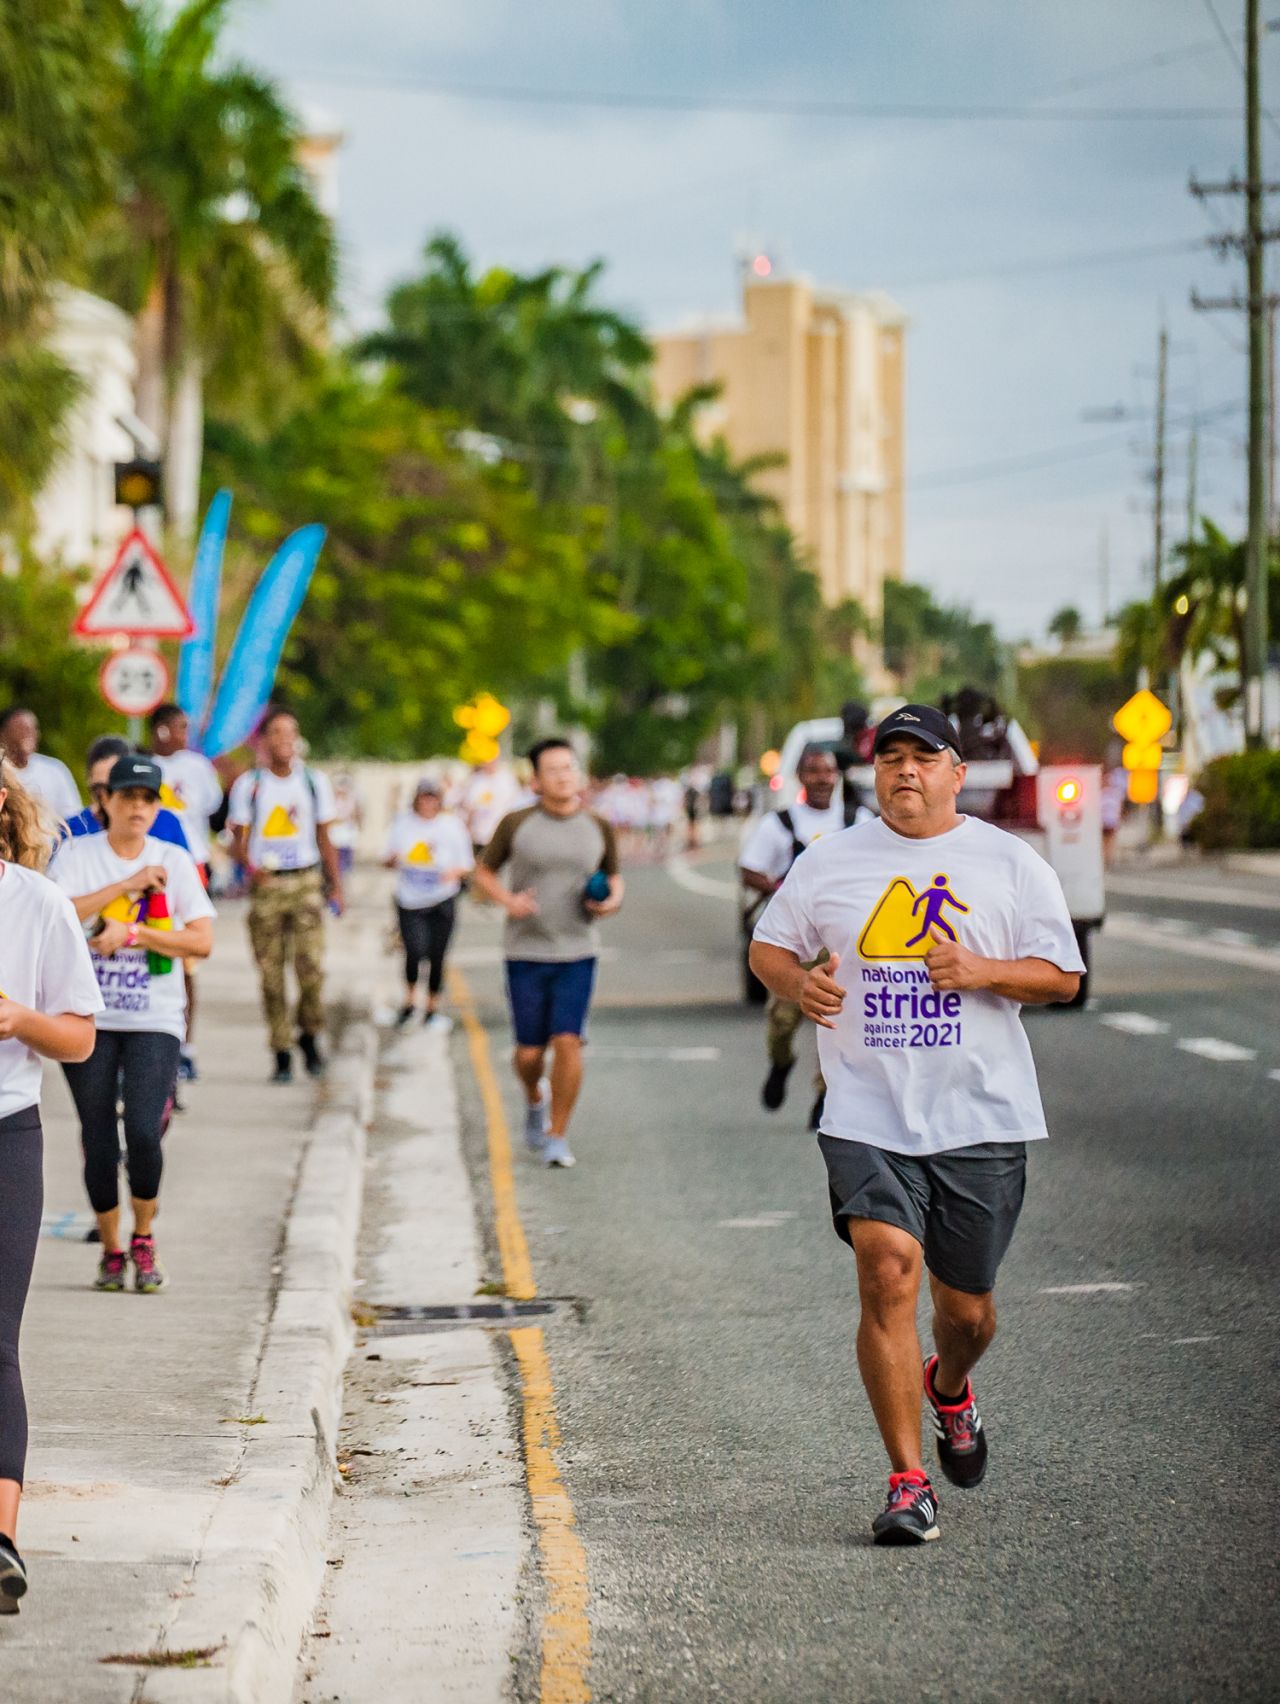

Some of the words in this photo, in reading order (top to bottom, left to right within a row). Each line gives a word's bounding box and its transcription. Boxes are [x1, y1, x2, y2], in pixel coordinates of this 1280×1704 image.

[95, 966, 151, 989] tride
[862, 966, 930, 984] nationw
[864, 985, 961, 1019] stride
[864, 1022, 907, 1035] against
[864, 1036, 907, 1048] cancer
[909, 1022, 961, 1047] 2021
